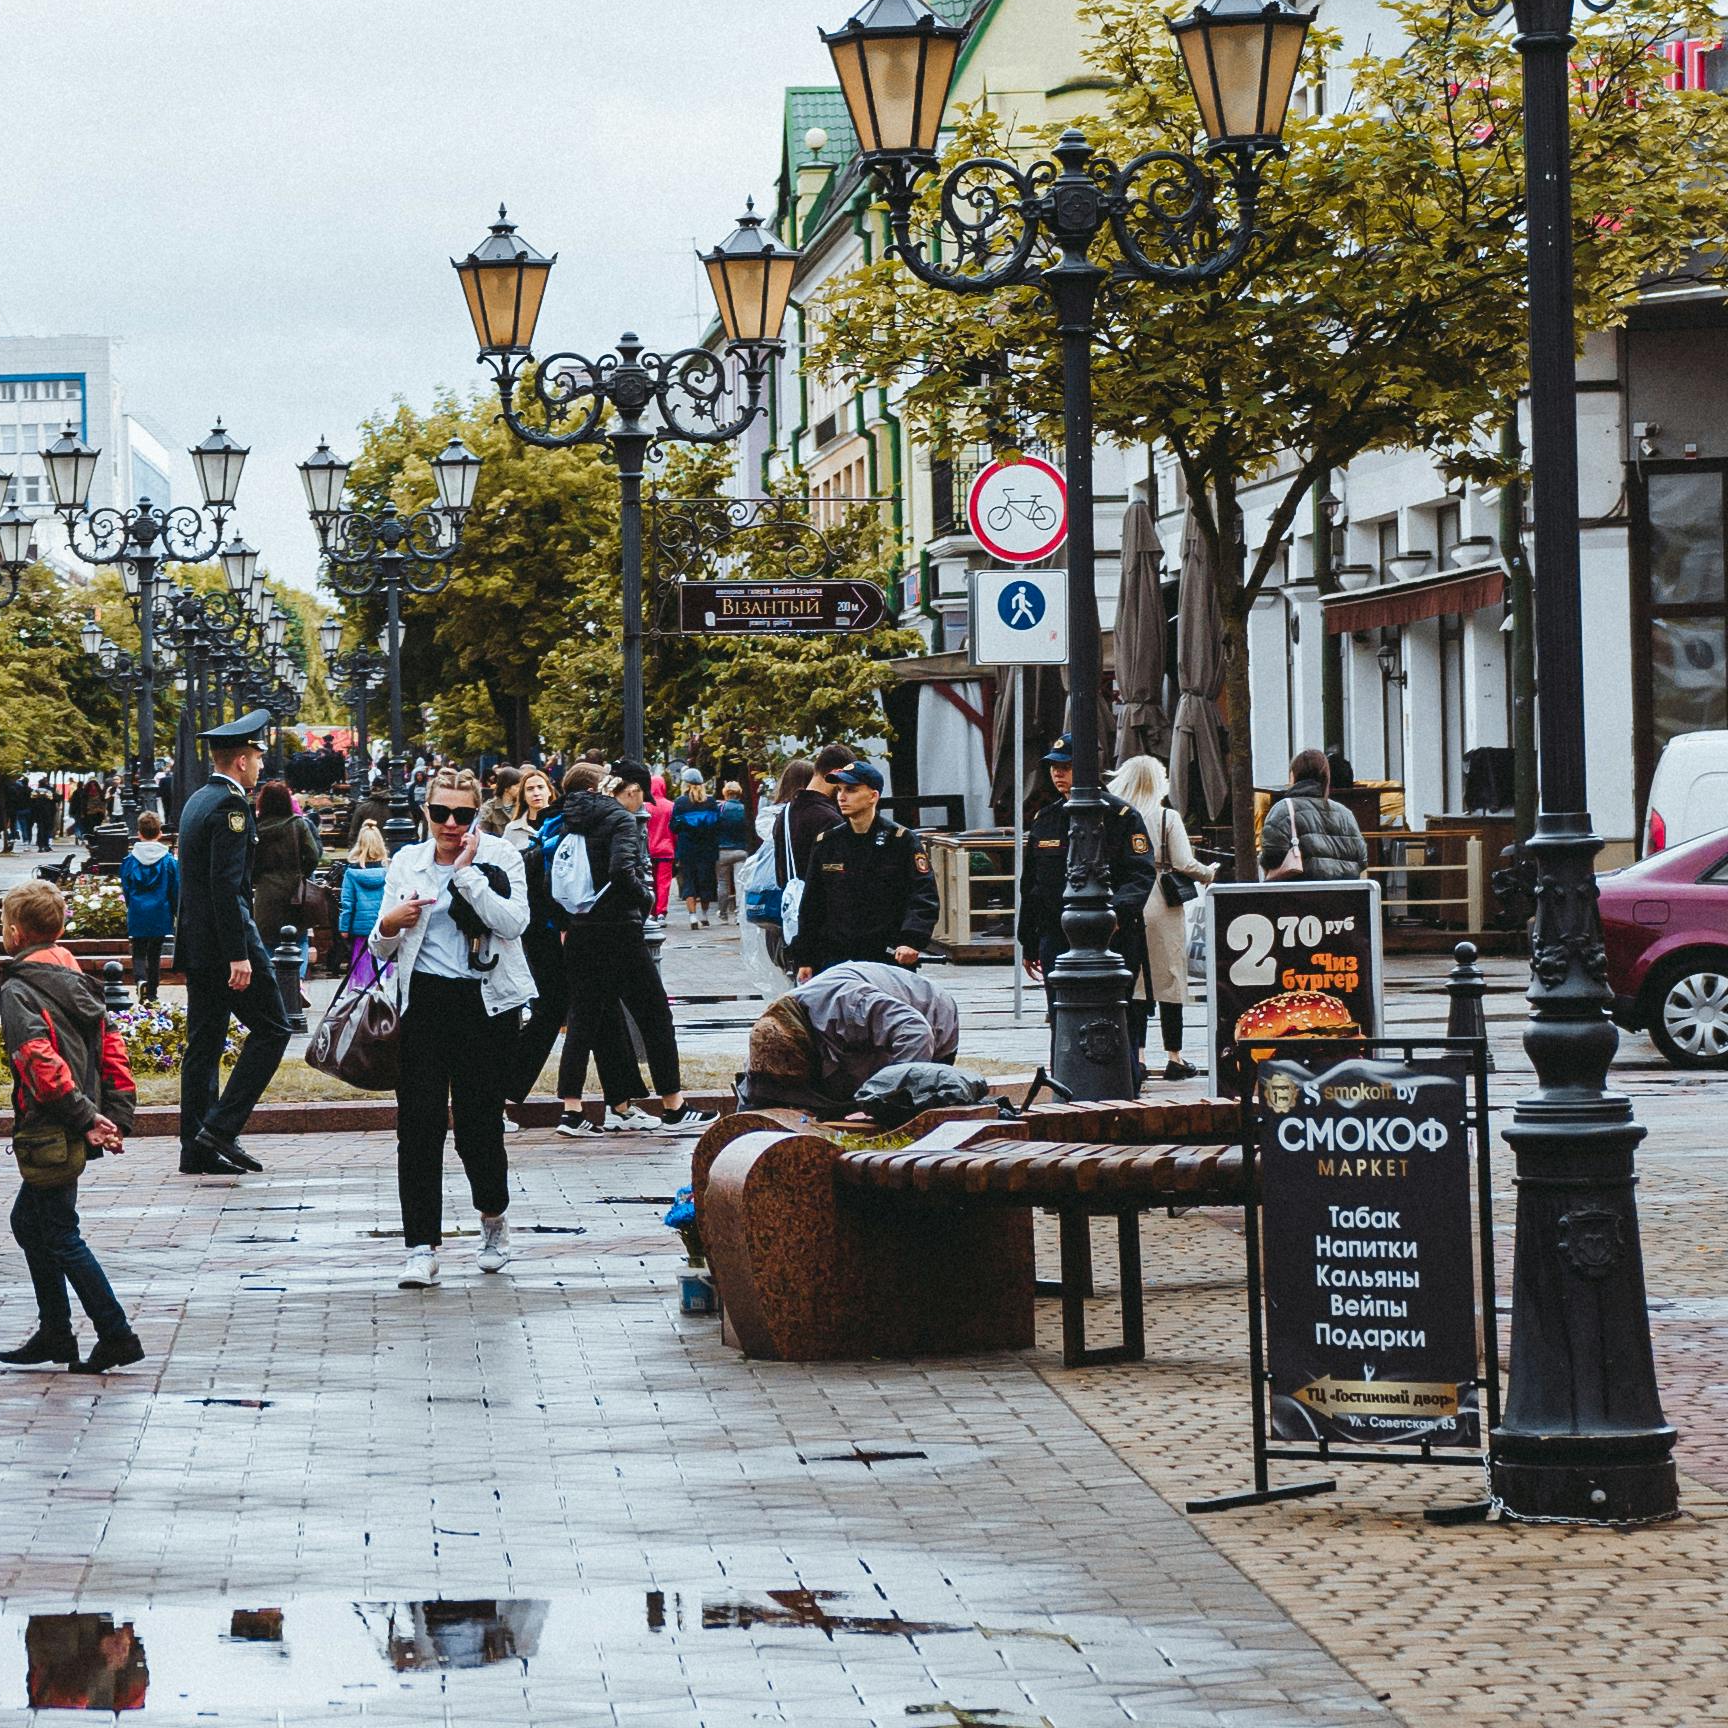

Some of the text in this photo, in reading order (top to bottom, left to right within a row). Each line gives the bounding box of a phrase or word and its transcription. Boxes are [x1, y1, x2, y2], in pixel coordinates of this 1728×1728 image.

[837, 601, 851, 612] 200
[1226, 913, 1355, 986] 2 70 руб
[1311, 953, 1358, 972] Чиз
[1281, 968, 1359, 992] бургер
[1278, 1116, 1449, 1152] СМОКОФ
[1318, 1158, 1409, 1177] МАРКЕТ
[1328, 1205, 1401, 1229] Табак
[1315, 1235, 1418, 1259] Напитки
[1316, 1264, 1420, 1288] Кальяны
[1330, 1294, 1408, 1318] Вейпы
[1315, 1322, 1426, 1352] Подарки
[1306, 1387, 1326, 1404] ТЦ
[1348, 1415, 1366, 1427] Ул.
